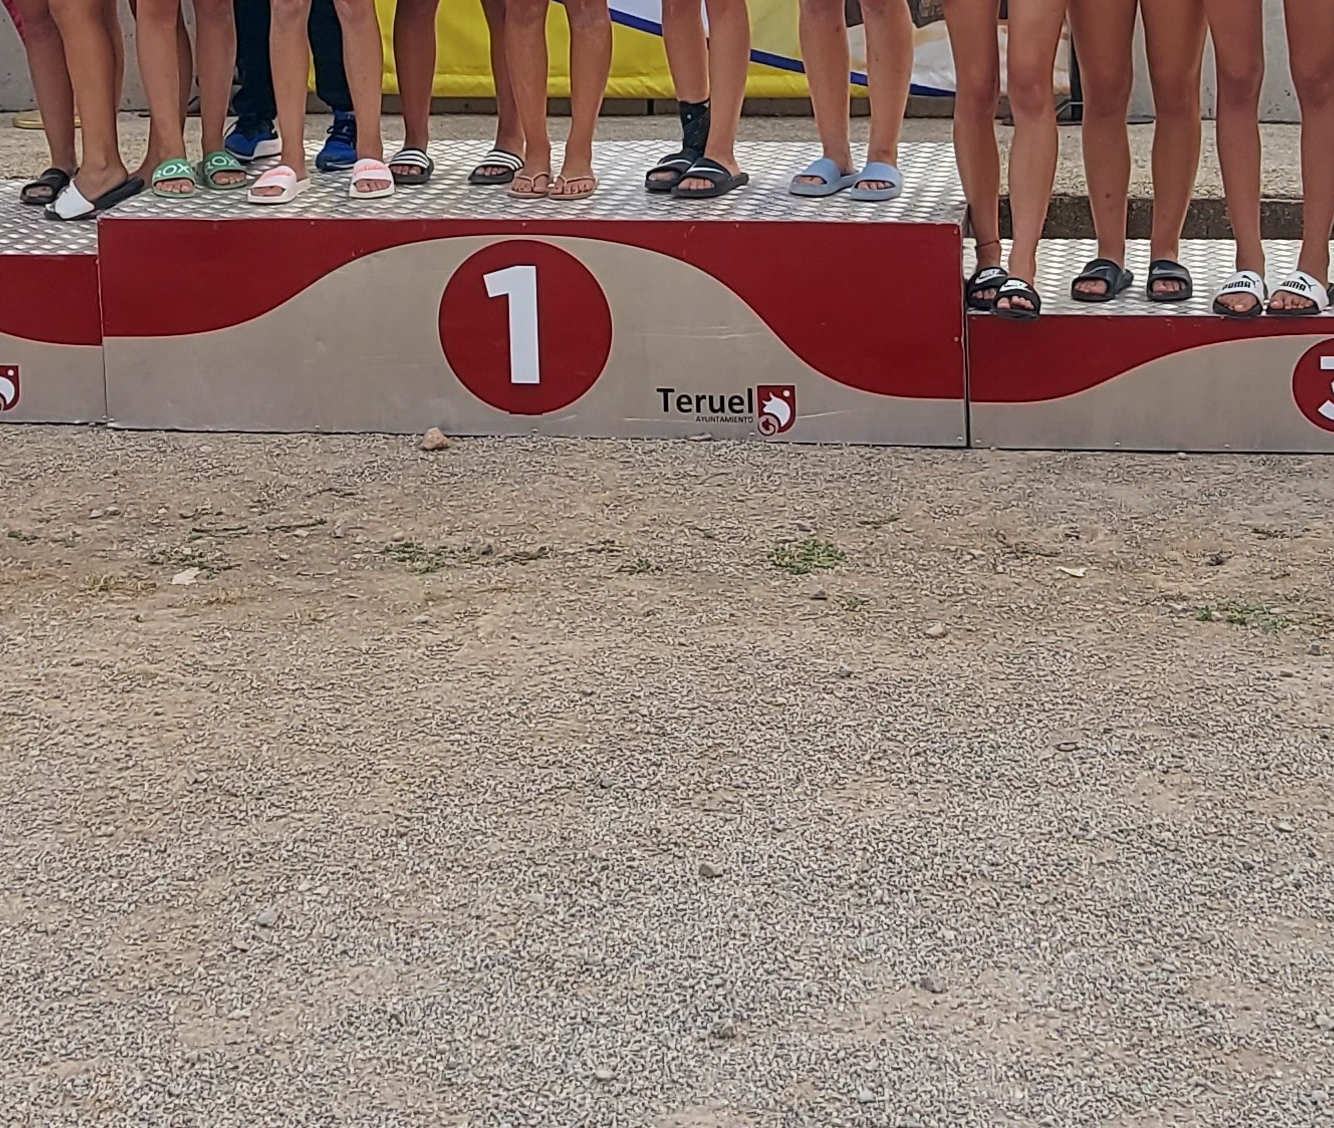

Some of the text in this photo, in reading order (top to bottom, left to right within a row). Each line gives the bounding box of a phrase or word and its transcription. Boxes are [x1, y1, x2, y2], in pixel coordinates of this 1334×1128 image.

[482, 265, 540, 384] 1
[656, 387, 754, 414] Teruel
[695, 415, 754, 424] AYUNTAMIENTO
